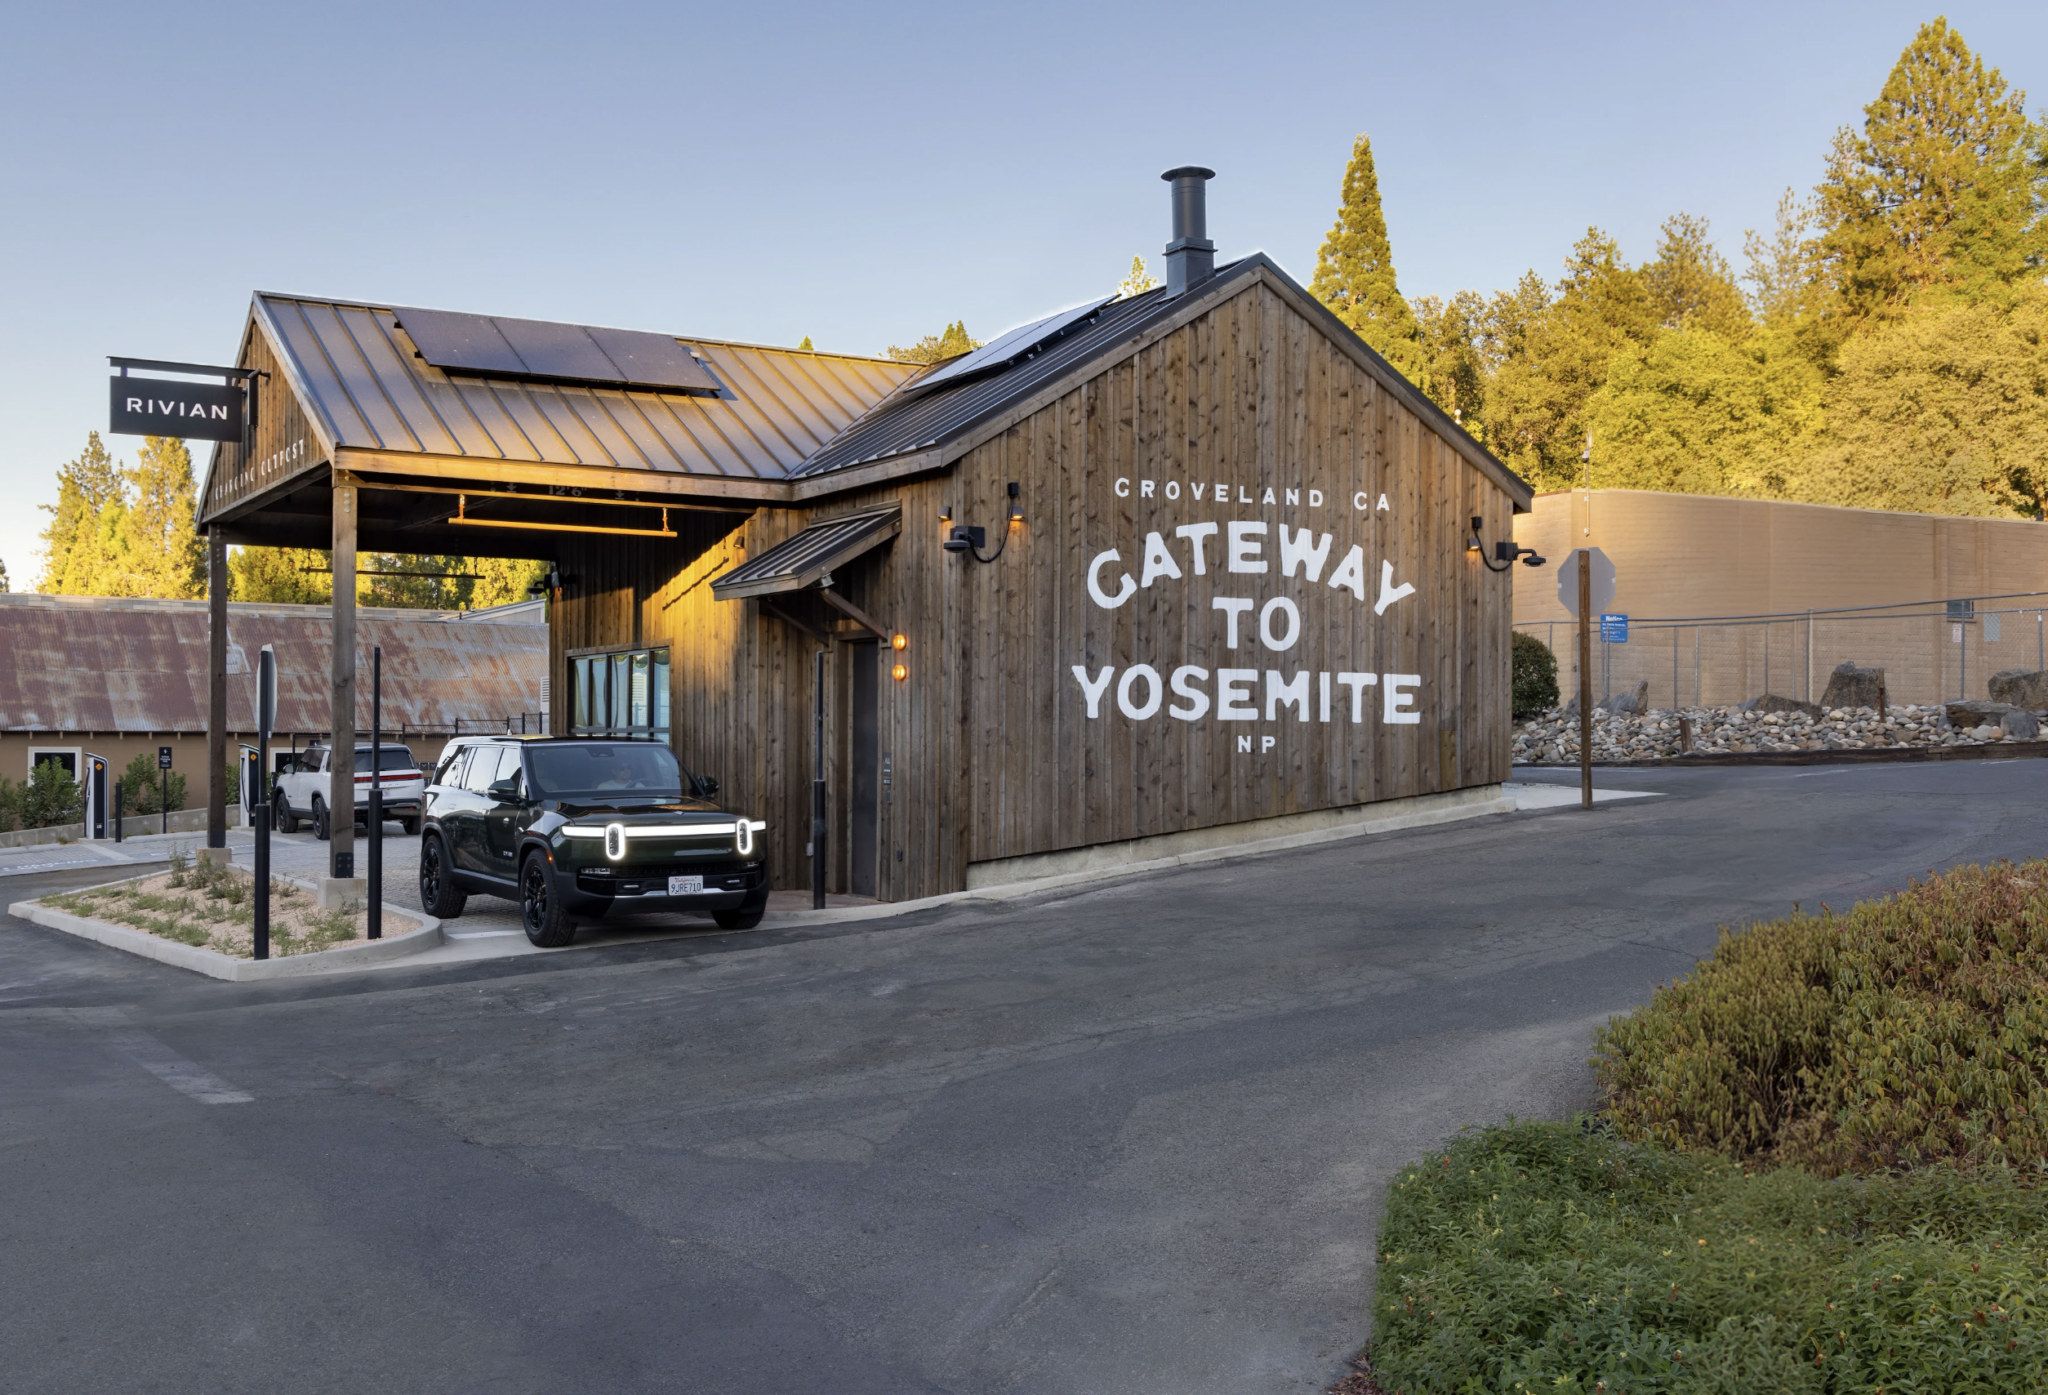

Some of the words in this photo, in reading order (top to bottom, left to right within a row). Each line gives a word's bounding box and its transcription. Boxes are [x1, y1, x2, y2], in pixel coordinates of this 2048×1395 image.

[126, 397, 228, 420] RIVIAN
[1114, 477, 1324, 507] GROVELAND
[1353, 492, 1390, 511] CA
[1087, 521, 1416, 616] GATEWAY
[1212, 596, 1301, 651] TO
[1071, 663, 1422, 724] YOSEMITE
[671, 883, 701, 893] 9JRE710
